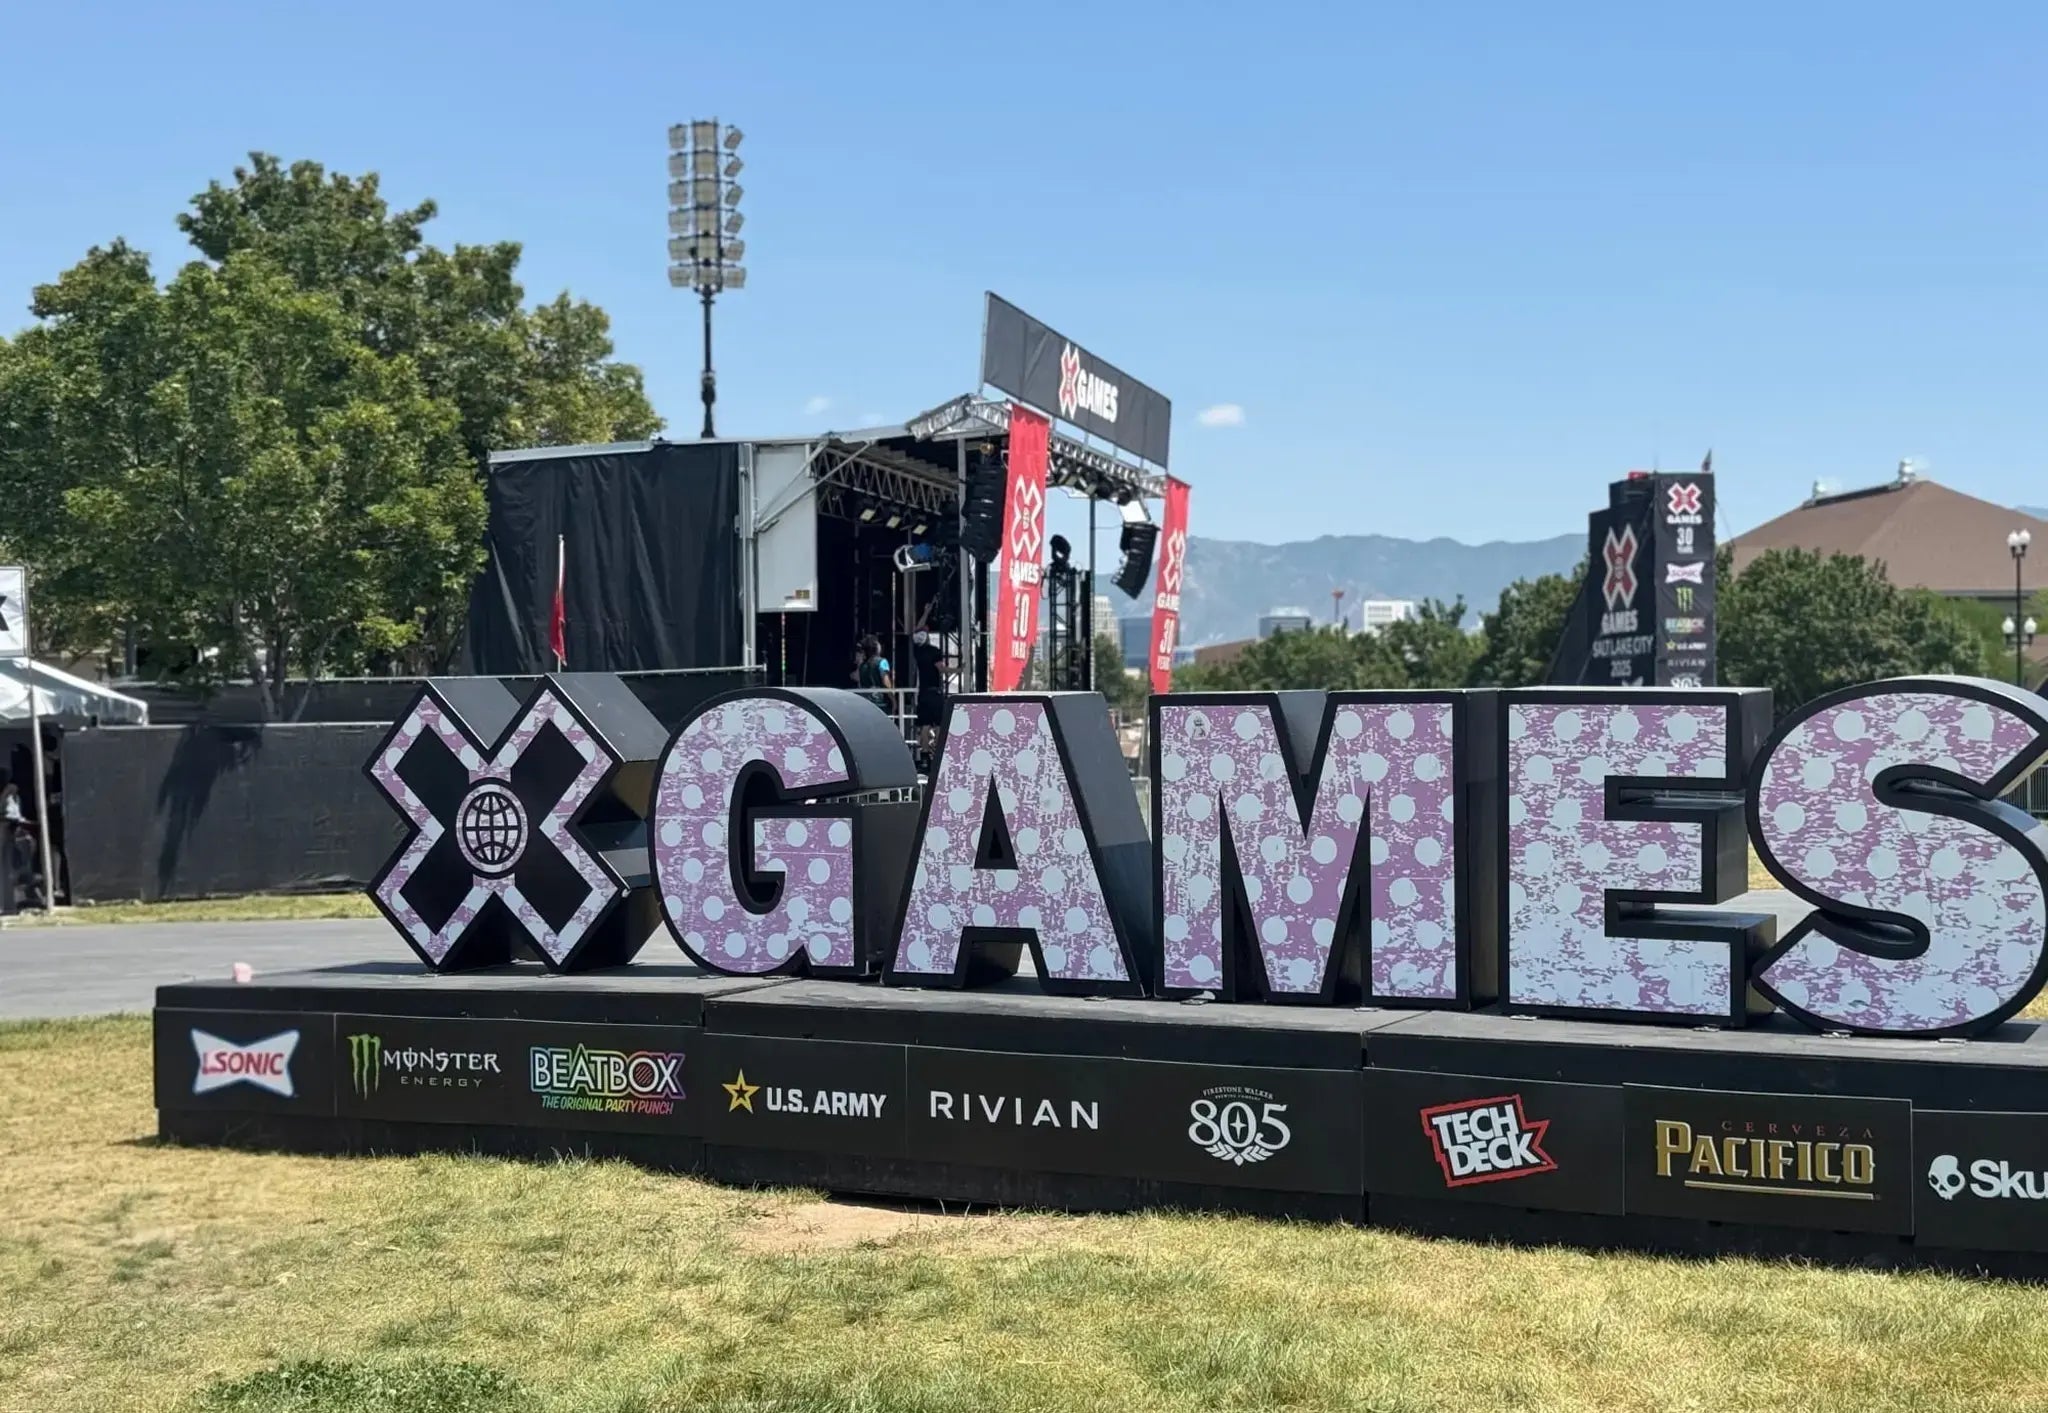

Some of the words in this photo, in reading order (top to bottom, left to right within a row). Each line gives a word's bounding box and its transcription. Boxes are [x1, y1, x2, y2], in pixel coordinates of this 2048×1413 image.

[1077, 368, 1118, 423] GAMES
[1667, 514, 1702, 524] GAMES
[1677, 527, 1694, 546] 30
[1157, 591, 1180, 611] GAME
[1601, 608, 1638, 634] GAMES
[1633, 634, 1654, 655] CITY
[649, 677, 2048, 1033] GAMES
[203, 1051, 284, 1075] SONIC
[383, 1047, 501, 1073] MONSTER
[533, 1050, 680, 1094] BEATBOX
[400, 1076, 482, 1088] ENERGY
[1202, 1086, 1242, 1097] FIRESTONE
[1244, 1087, 1274, 1100] WALKER
[542, 1095, 560, 1109] THE
[560, 1096, 603, 1112] ORIGINAL
[605, 1099, 637, 1113] PARTY
[638, 1101, 674, 1115] PUNCH
[766, 1087, 809, 1113] U.S.
[812, 1090, 887, 1118] ARMY
[930, 1091, 1098, 1130] RIVIAN
[1188, 1100, 1291, 1150] 805
[1431, 1104, 1519, 1149] TECH
[1721, 1120, 1874, 1139] CERVEZA
[1447, 1132, 1541, 1176] DECK
